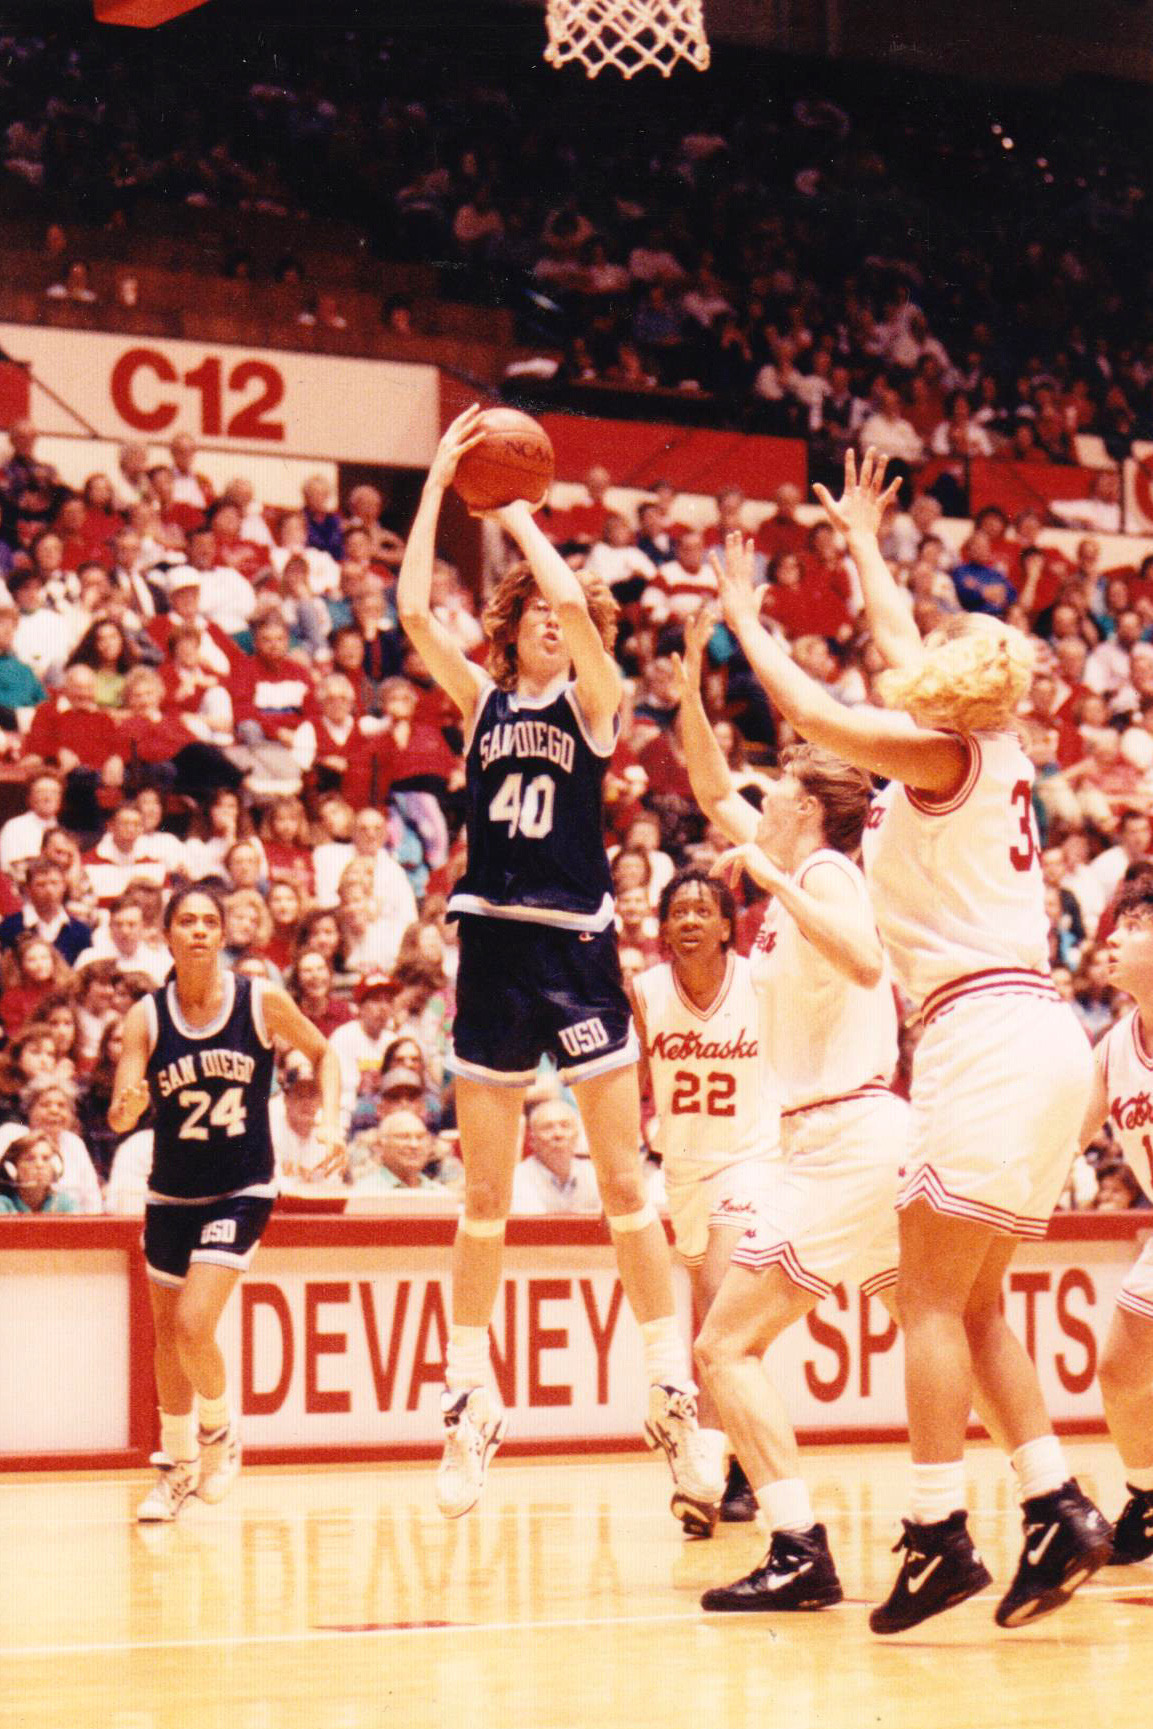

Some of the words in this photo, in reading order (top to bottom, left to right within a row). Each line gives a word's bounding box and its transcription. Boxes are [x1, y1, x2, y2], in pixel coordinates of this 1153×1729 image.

[110, 346, 285, 441] C12
[513, 720, 575, 774] DIEGO
[489, 772, 555, 839] 40
[558, 1016, 609, 1057] USD
[650, 1027, 759, 1060] Nebraska
[158, 1054, 198, 1097] SAN
[200, 1048, 256, 1084] DIEGO
[671, 1070, 736, 1117] 22
[178, 1086, 247, 1141] 24
[200, 1218, 237, 1245] USD
[241, 1278, 625, 1415] DEVANEY
[803, 1267, 1098, 1403] SPTS
